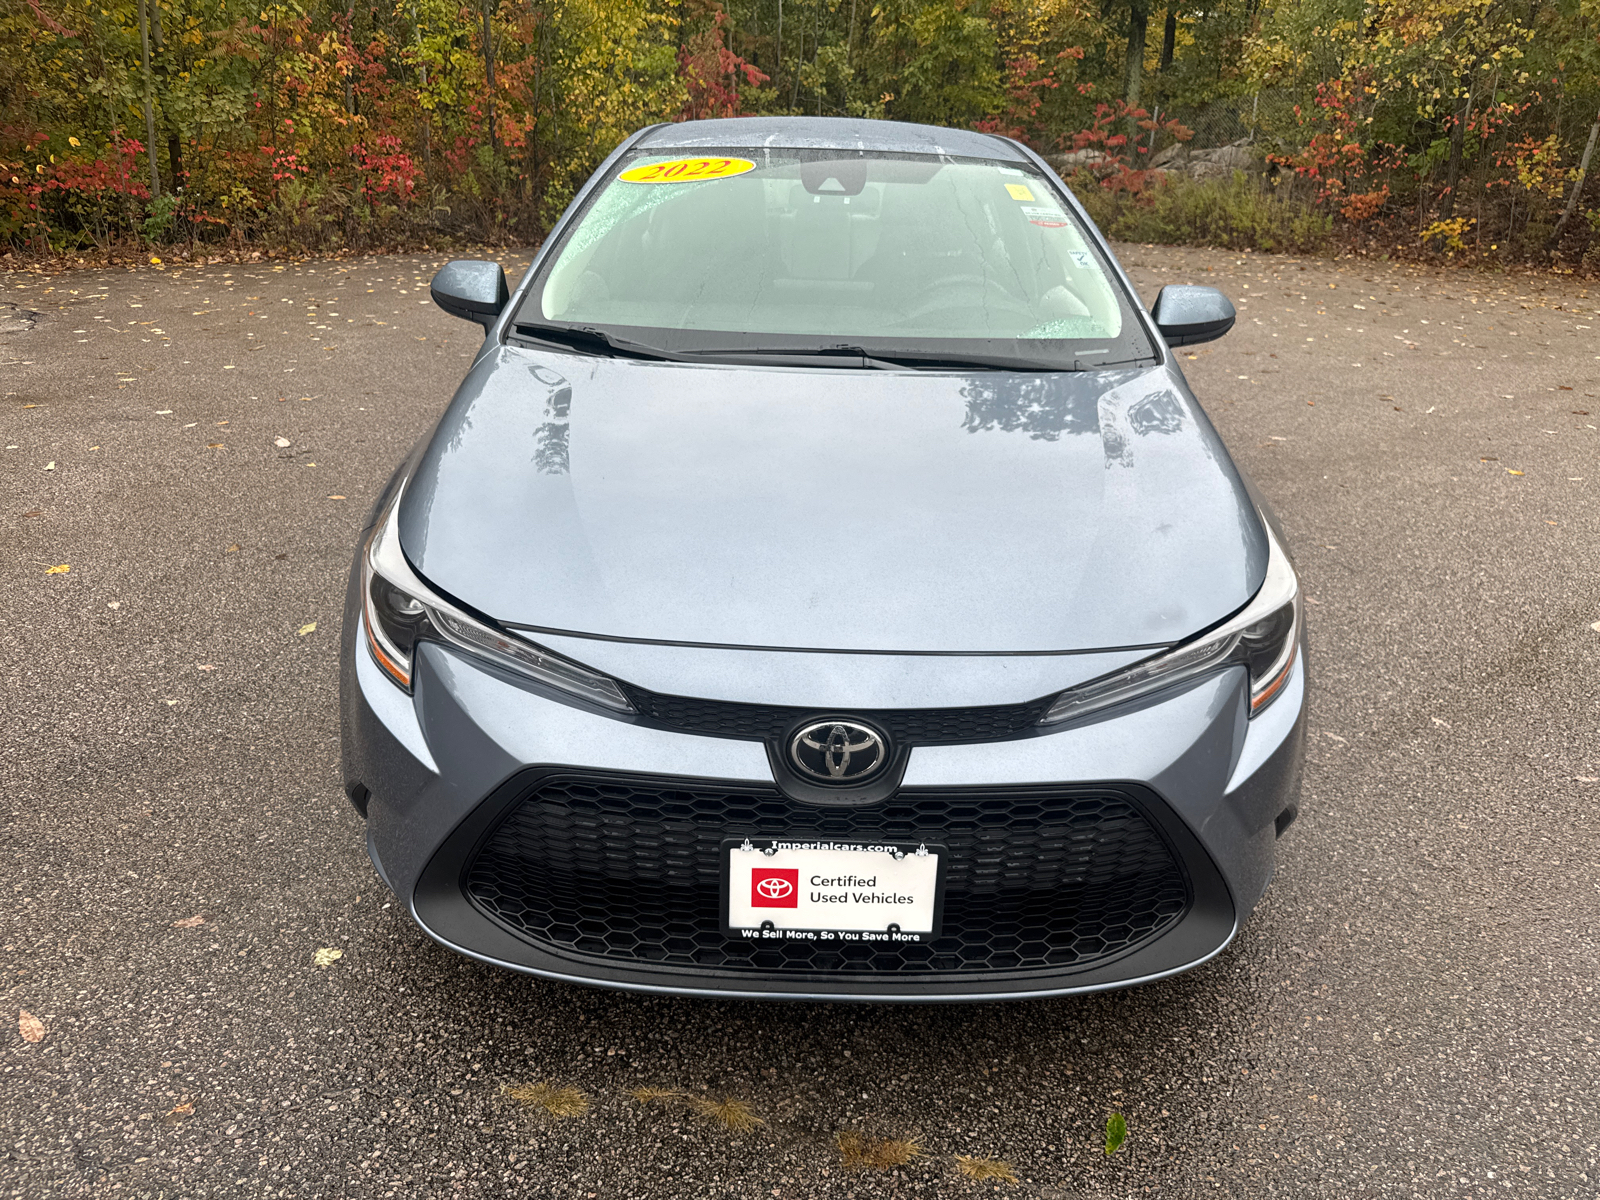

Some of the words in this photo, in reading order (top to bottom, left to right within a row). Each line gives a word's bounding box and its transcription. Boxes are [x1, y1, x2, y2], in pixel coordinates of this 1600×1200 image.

[638, 160, 731, 180] 2022
[771, 840, 898, 853] Imperialcars.com
[810, 875, 877, 888] Certified
[810, 892, 848, 904] Used
[852, 892, 914, 905] Vehicles
[741, 929, 759, 938] We
[762, 929, 783, 939] Sell
[787, 930, 817, 940] More,
[820, 931, 835, 940] So
[838, 931, 859, 940] You
[862, 931, 889, 941] Save
[892, 932, 920, 942] More
